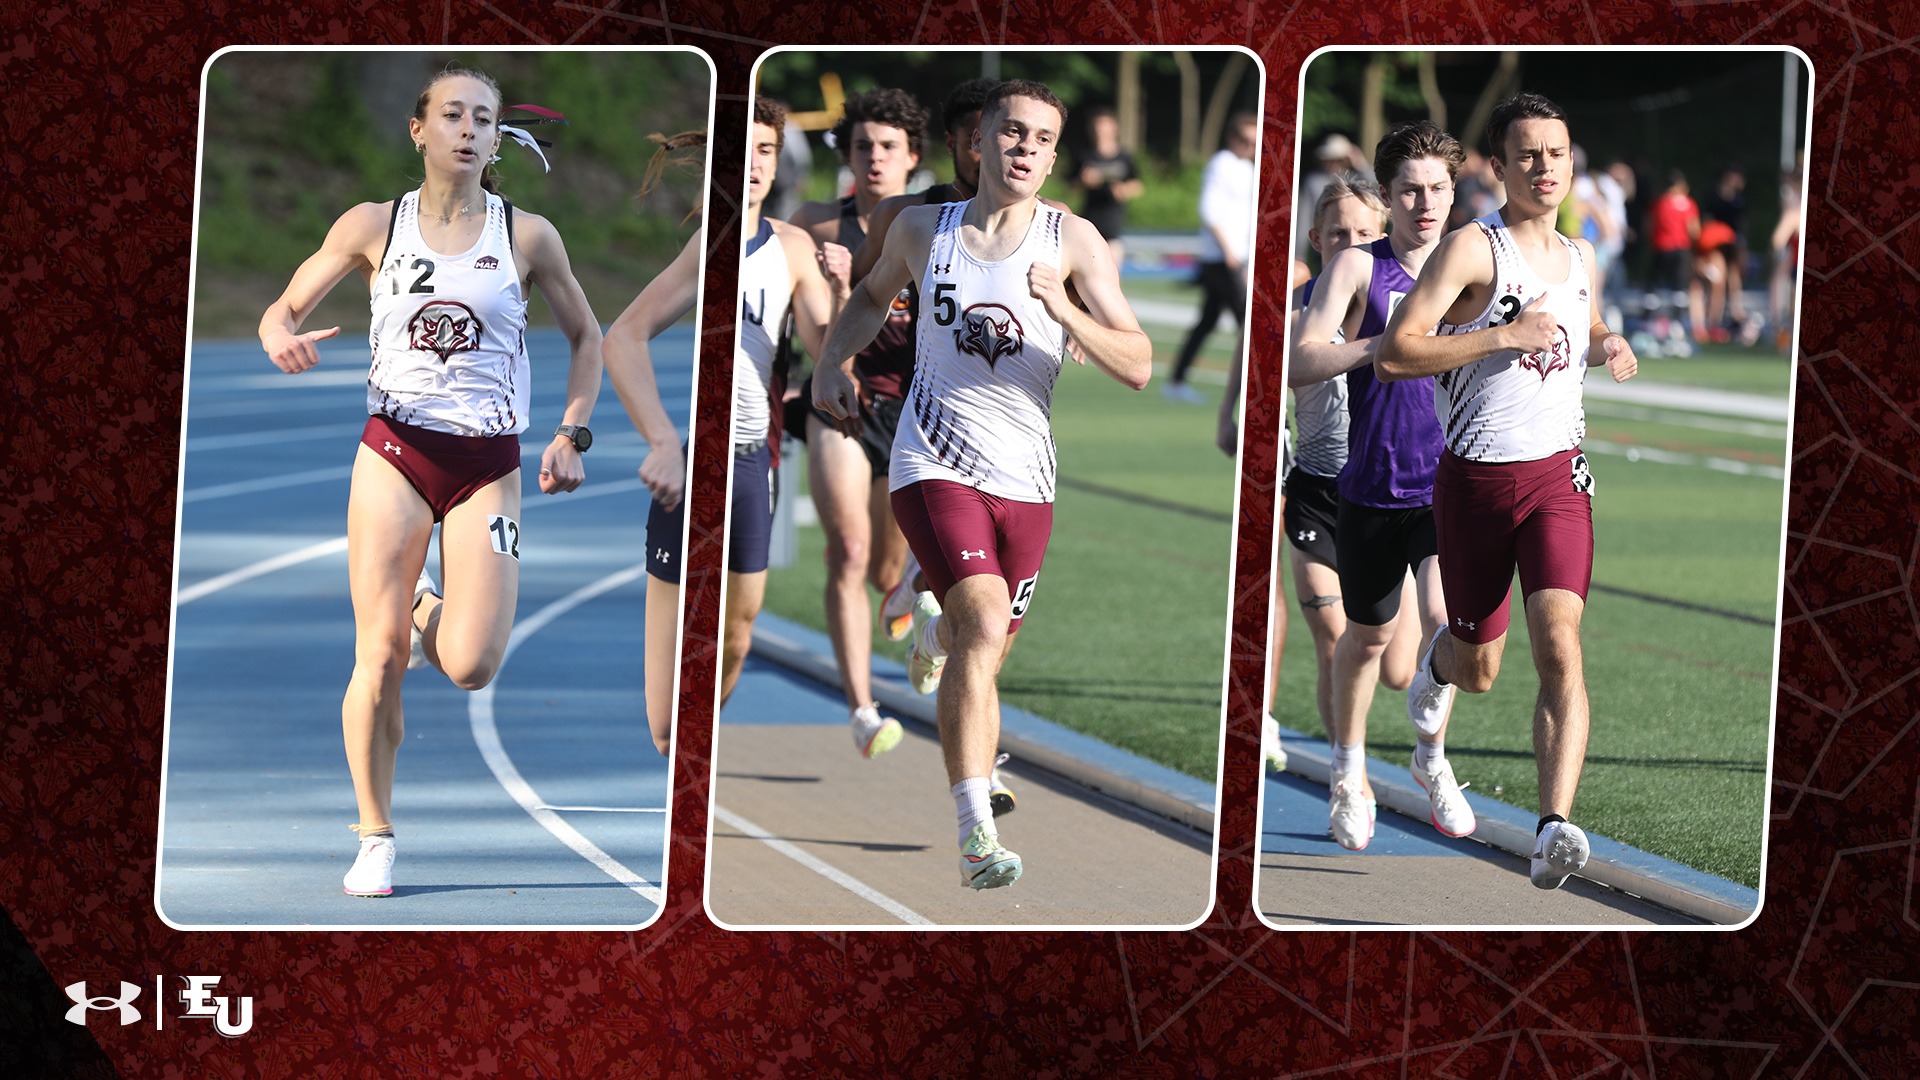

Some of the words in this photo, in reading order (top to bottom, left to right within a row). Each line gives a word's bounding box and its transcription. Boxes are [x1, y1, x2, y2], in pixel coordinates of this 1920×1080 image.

[385, 258, 435, 295] 12
[475, 261, 497, 269] MAC
[933, 283, 957, 326] 5
[489, 516, 519, 560] 12
[1012, 578, 1036, 616] 5
